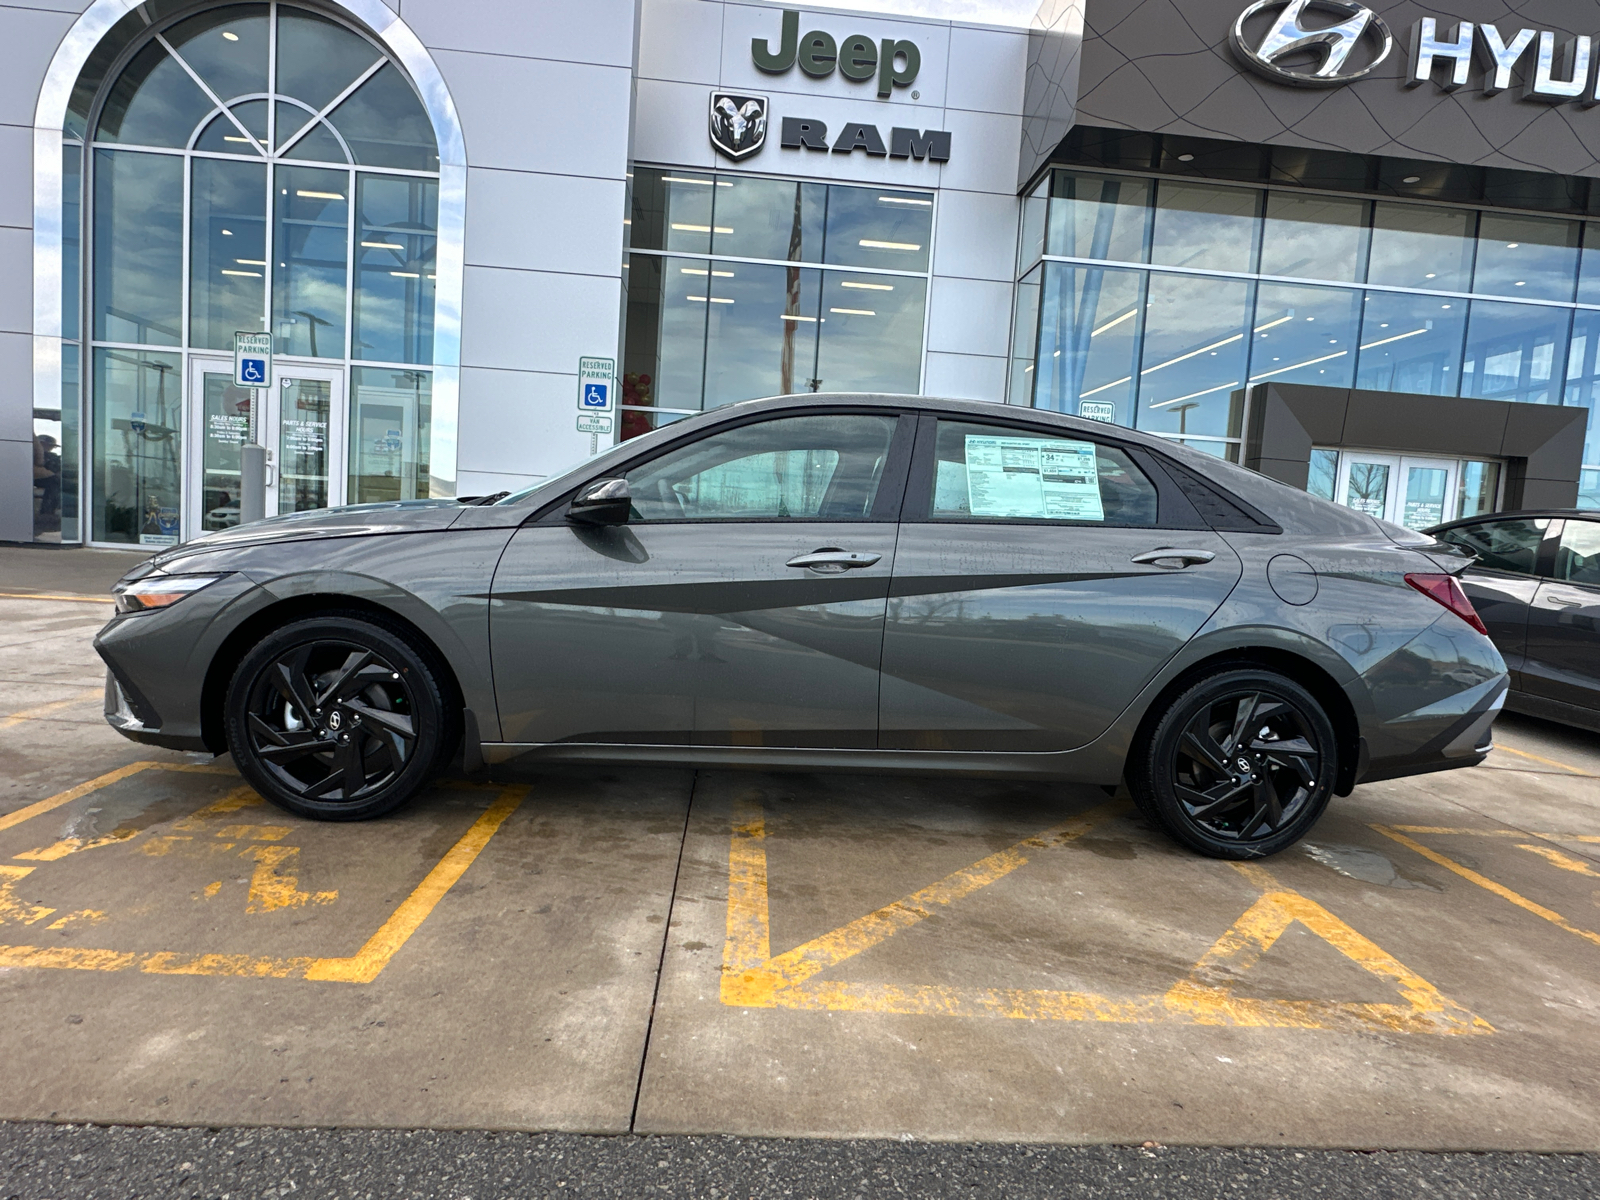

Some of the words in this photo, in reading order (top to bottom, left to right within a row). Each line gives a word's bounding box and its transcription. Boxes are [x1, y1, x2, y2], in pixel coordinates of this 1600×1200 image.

[751, 10, 921, 98] Jeep
[1408, 17, 1600, 106] HYU
[781, 116, 952, 162] RAM
[238, 335, 269, 345] RESERVED
[238, 345, 269, 355] PARKING
[582, 361, 611, 370] RESERVED
[582, 370, 611, 379] PARKING
[1083, 405, 1110, 415] RESERVED
[578, 423, 610, 431] ACCESSIBLE
[229, 717, 249, 767] KUMHO
